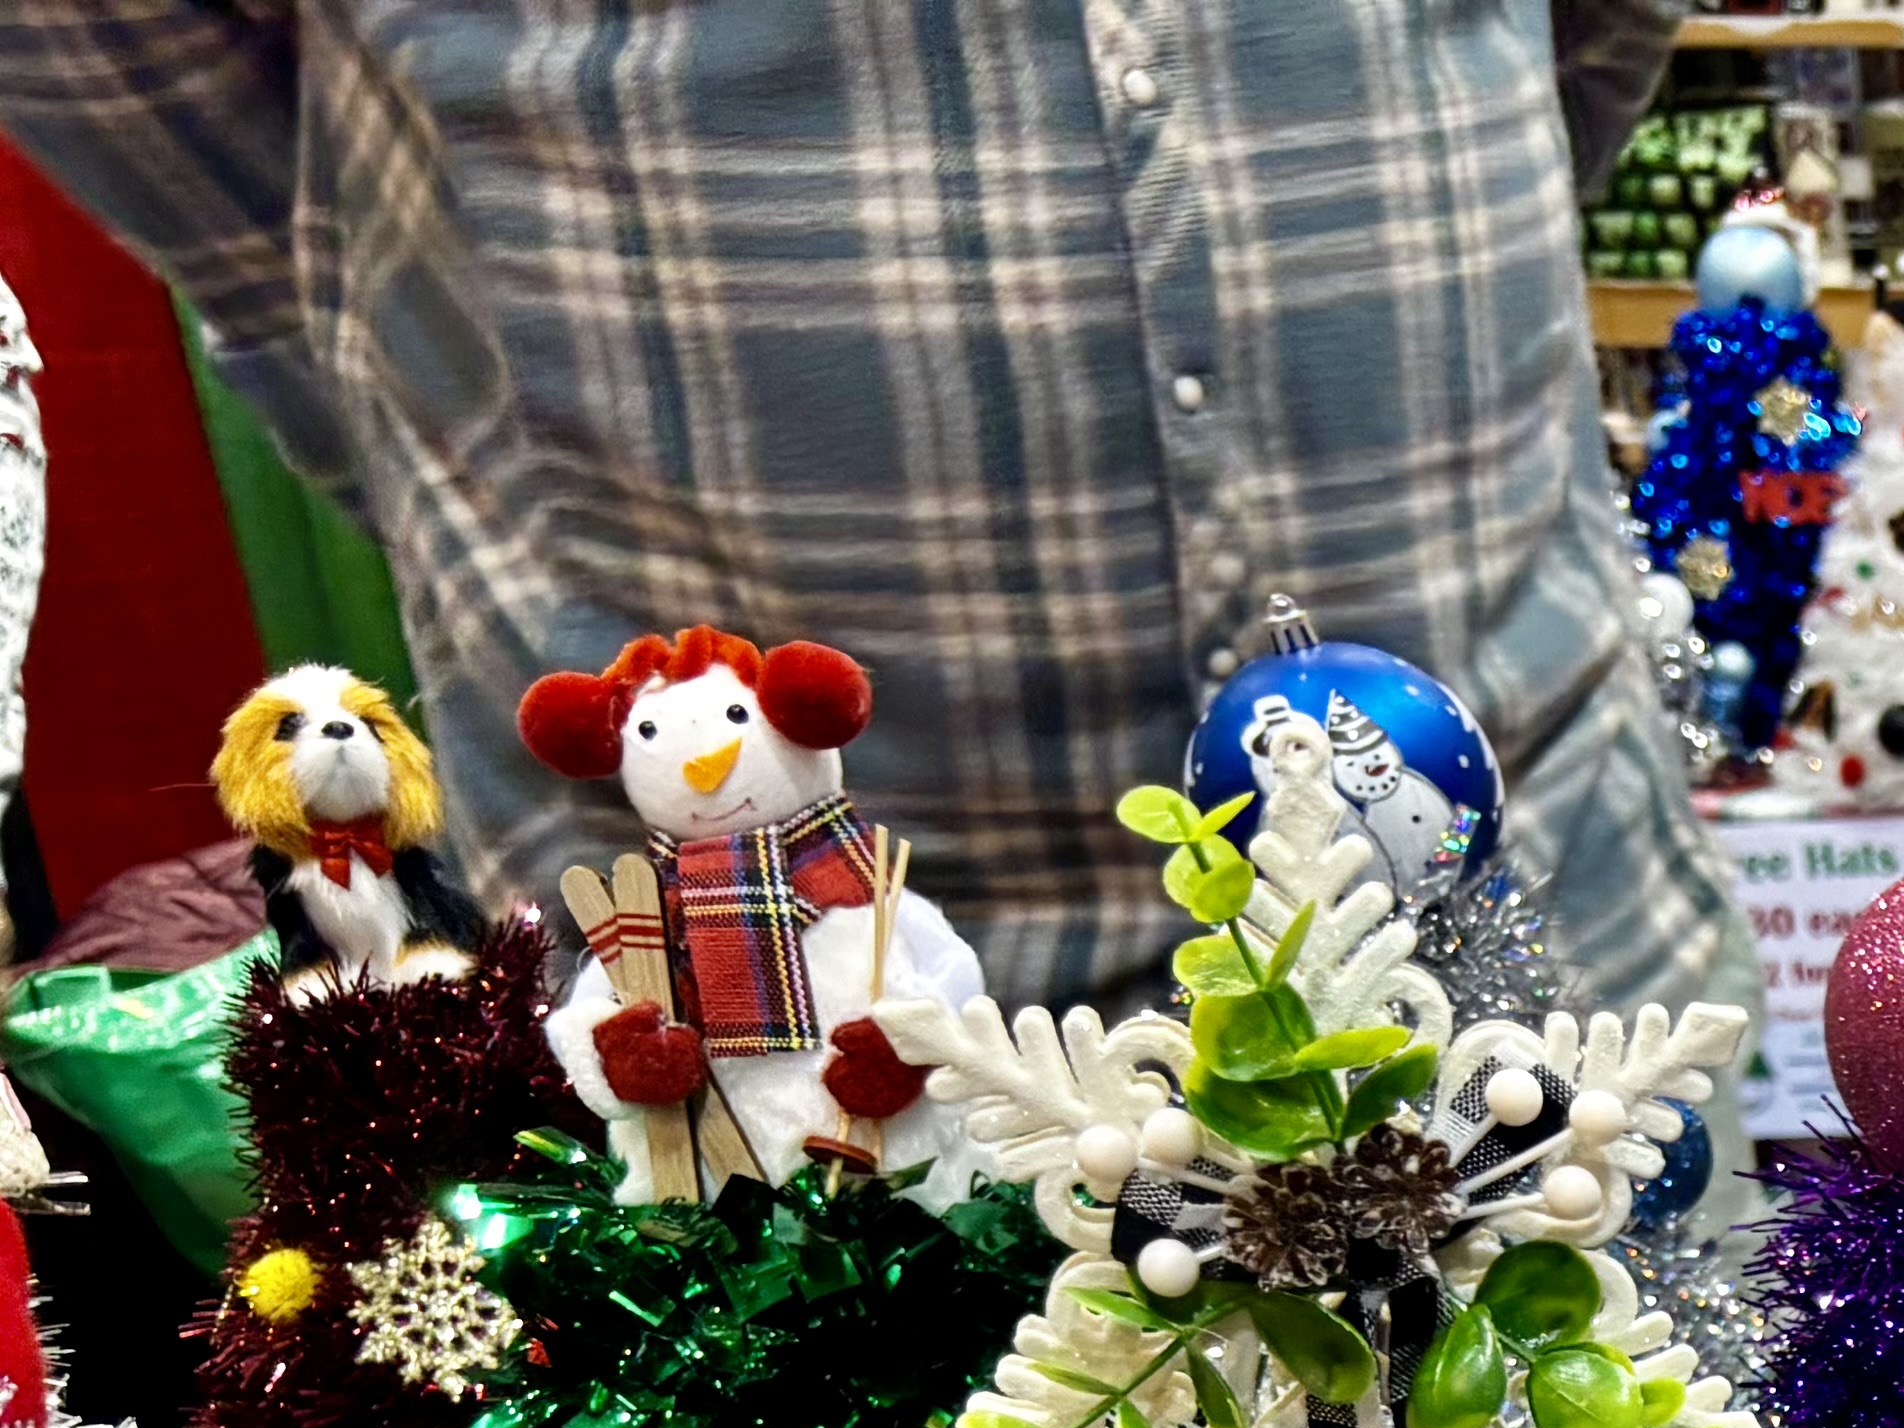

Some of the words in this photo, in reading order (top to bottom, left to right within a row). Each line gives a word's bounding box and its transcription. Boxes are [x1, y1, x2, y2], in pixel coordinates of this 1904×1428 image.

[1742, 853, 1791, 884] ee
[1803, 841, 1899, 878] Hats
[1806, 909, 1862, 938] ea
